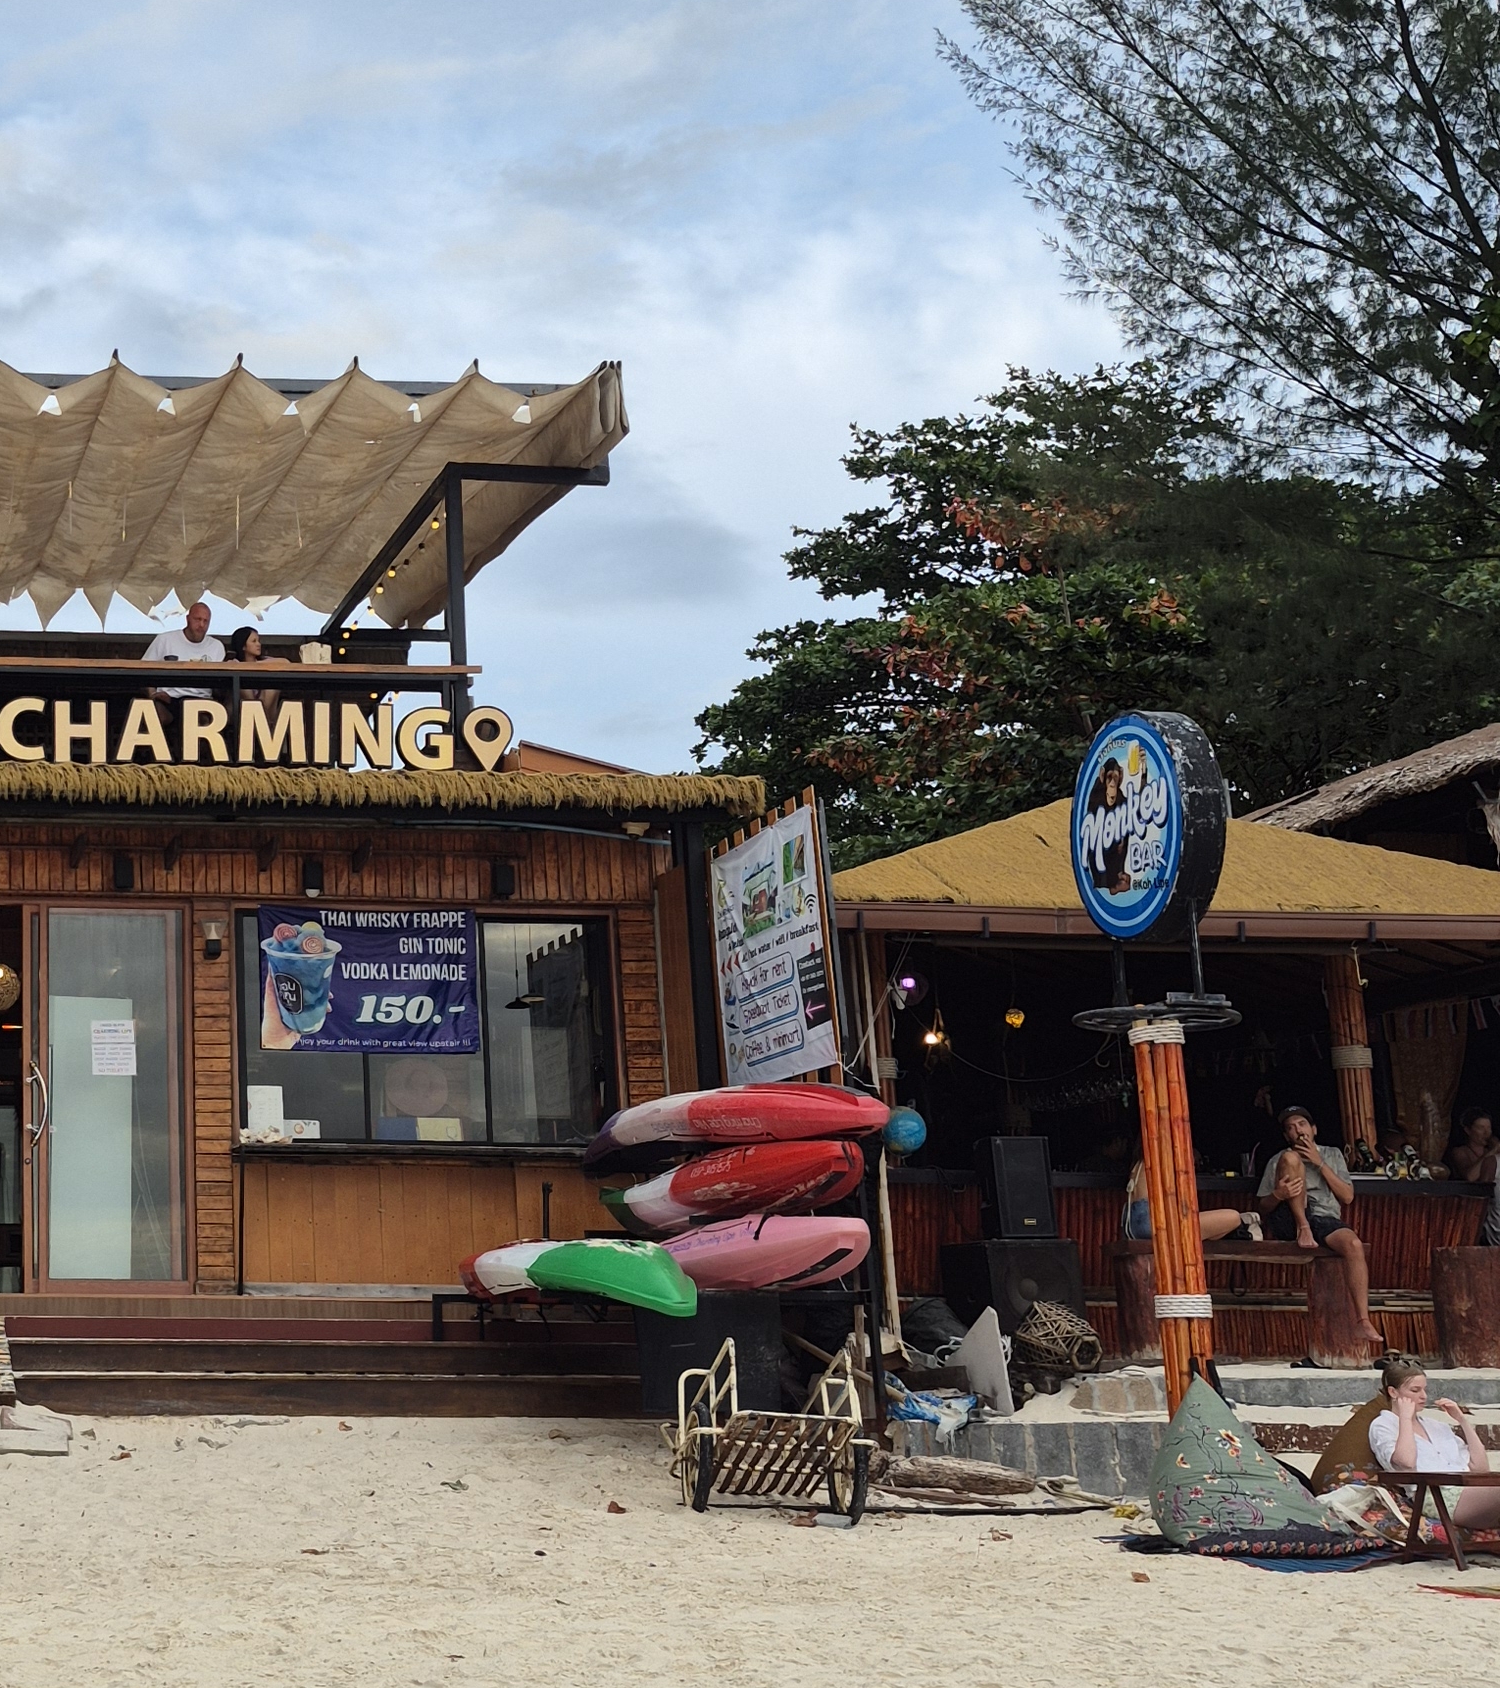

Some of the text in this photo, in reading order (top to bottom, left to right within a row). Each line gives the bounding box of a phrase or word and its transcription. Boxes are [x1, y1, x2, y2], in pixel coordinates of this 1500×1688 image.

[1080, 776, 1169, 873] Monkey
[1130, 840, 1167, 874] BAR
[320, 911, 466, 928] THAI WRISKY FRAPPE
[789, 922, 820, 940] breakfast
[400, 937, 466, 955] GIN TONIC
[341, 962, 467, 981] VODKA LEMONADE
[759, 966, 769, 984] for
[772, 957, 787, 979] rent
[338, 1037, 360, 1046] drink
[362, 1037, 381, 1046] with
[383, 1039, 406, 1048] great
[408, 1039, 428, 1047] view
[745, 1037, 764, 1060] Coffee
